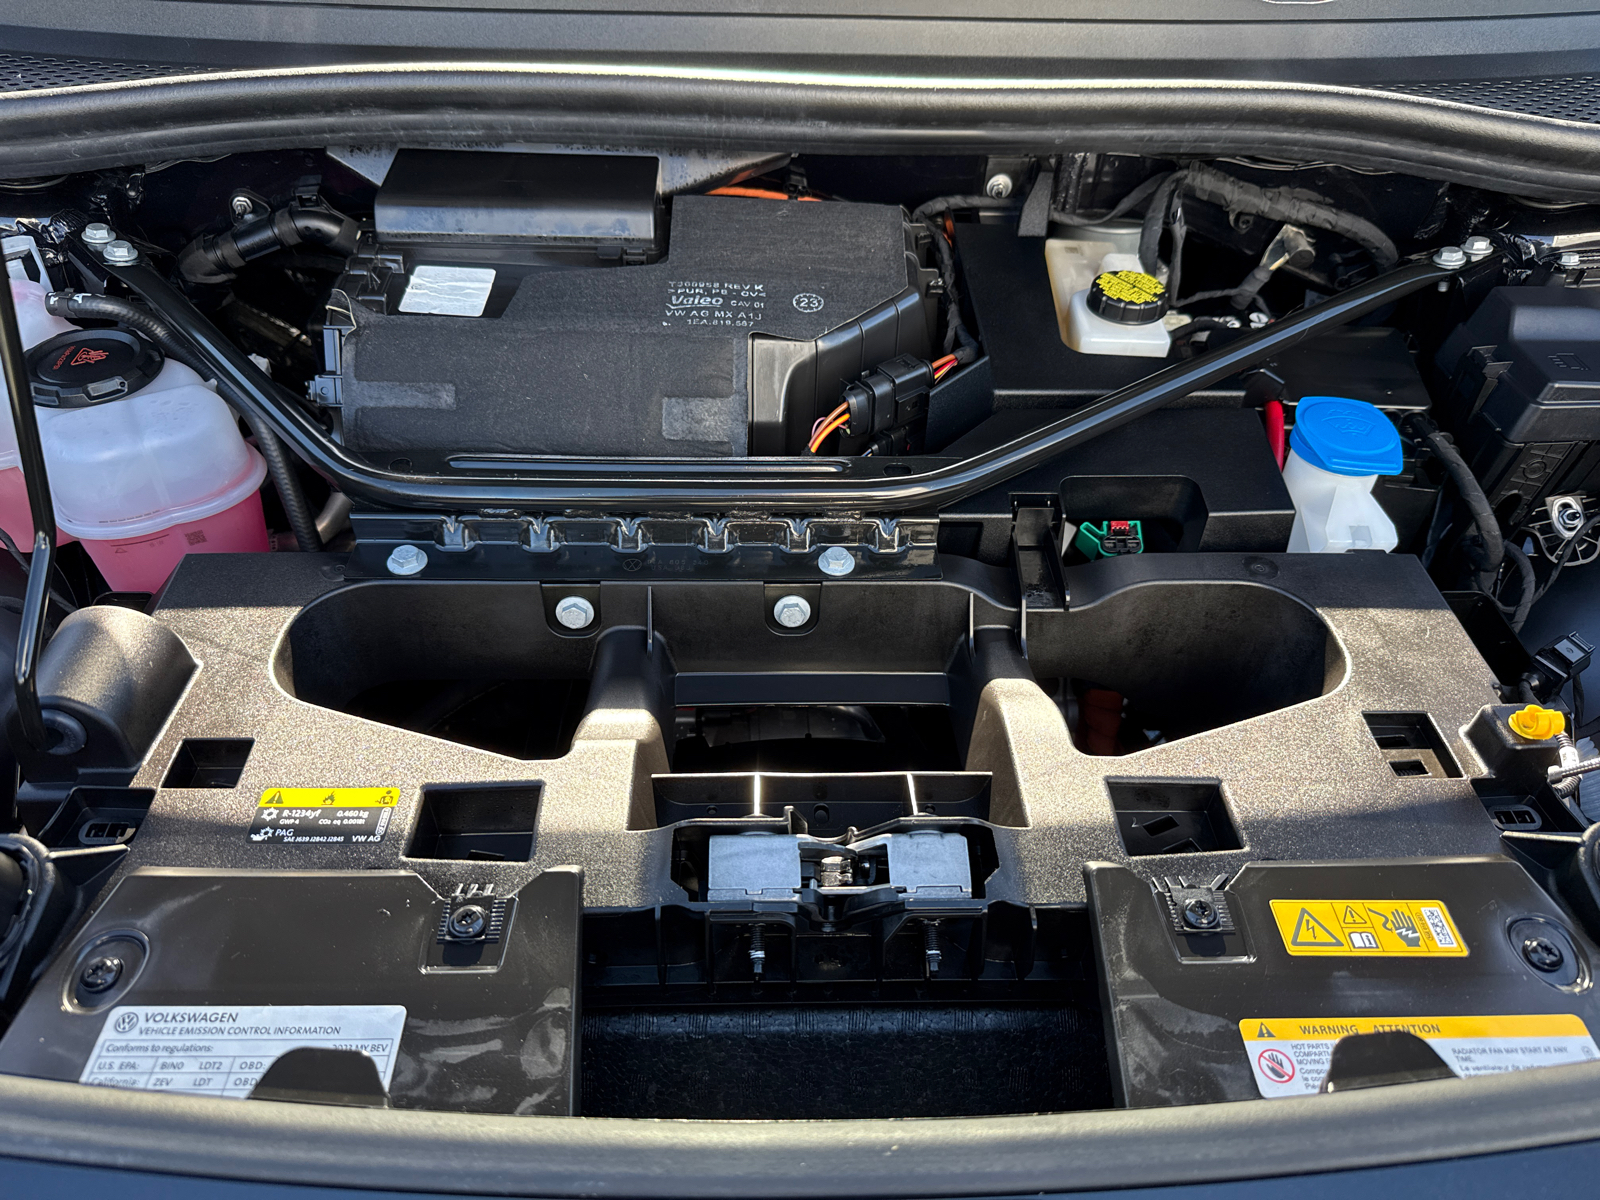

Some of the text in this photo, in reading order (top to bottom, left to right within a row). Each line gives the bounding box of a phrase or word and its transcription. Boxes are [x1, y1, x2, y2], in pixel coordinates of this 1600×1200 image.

[671, 294, 724, 306] Valeo
[799, 297, 819, 307] 23
[665, 309, 686, 317] VW
[714, 310, 733, 319] MX
[282, 809, 322, 819] R-1234yf
[359, 810, 369, 818] kg
[275, 828, 294, 836] PAG
[352, 835, 381, 843] VW AG
[145, 1012, 239, 1023] VOLKSWAGEN
[139, 1026, 342, 1036] VEHICLE EMISSION CONTROL INFORMATION
[1299, 1023, 1441, 1036] WARNING ATTENTION
[105, 1043, 214, 1055] Conforms to regulations:
[355, 1043, 370, 1051] MY
[370, 1043, 389, 1053] BEV
[1291, 1043, 1305, 1051] HOT
[1306, 1042, 1330, 1050] PARTS
[1451, 1047, 1488, 1055] RADIATOR
[1488, 1047, 1504, 1055] FAN
[1520, 1046, 1542, 1055] START
[1553, 1045, 1568, 1053] ANY
[97, 1061, 140, 1071] U.S. EPA:
[198, 1061, 223, 1071] LDT2
[239, 1061, 266, 1071] OBD:
[1296, 1058, 1325, 1066] MOVING
[152, 1077, 213, 1087] ZEV LDT
